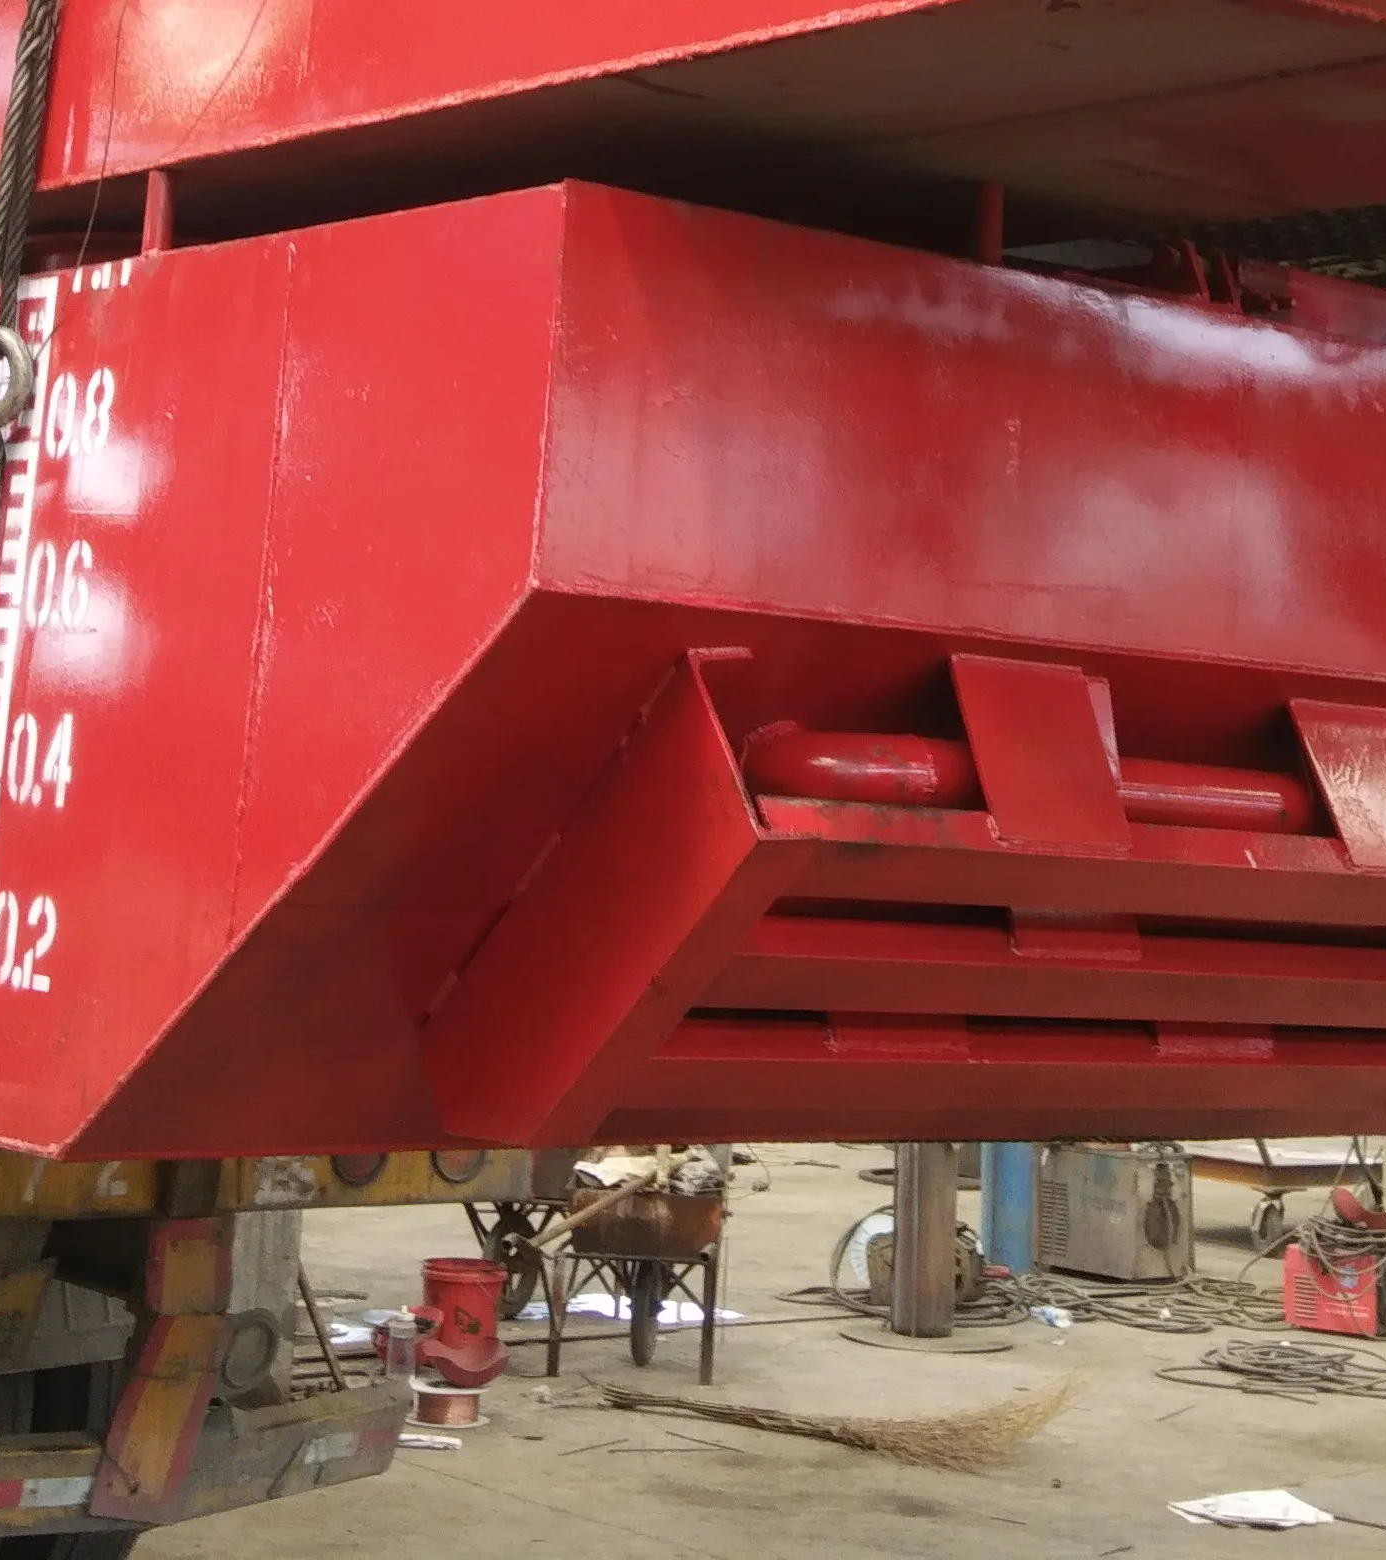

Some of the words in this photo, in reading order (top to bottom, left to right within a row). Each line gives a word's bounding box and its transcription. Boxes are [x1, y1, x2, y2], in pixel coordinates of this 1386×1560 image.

[46, 367, 114, 460] 0.8
[26, 539, 93, 627] 0.6
[7, 712, 73, 809] 0.4
